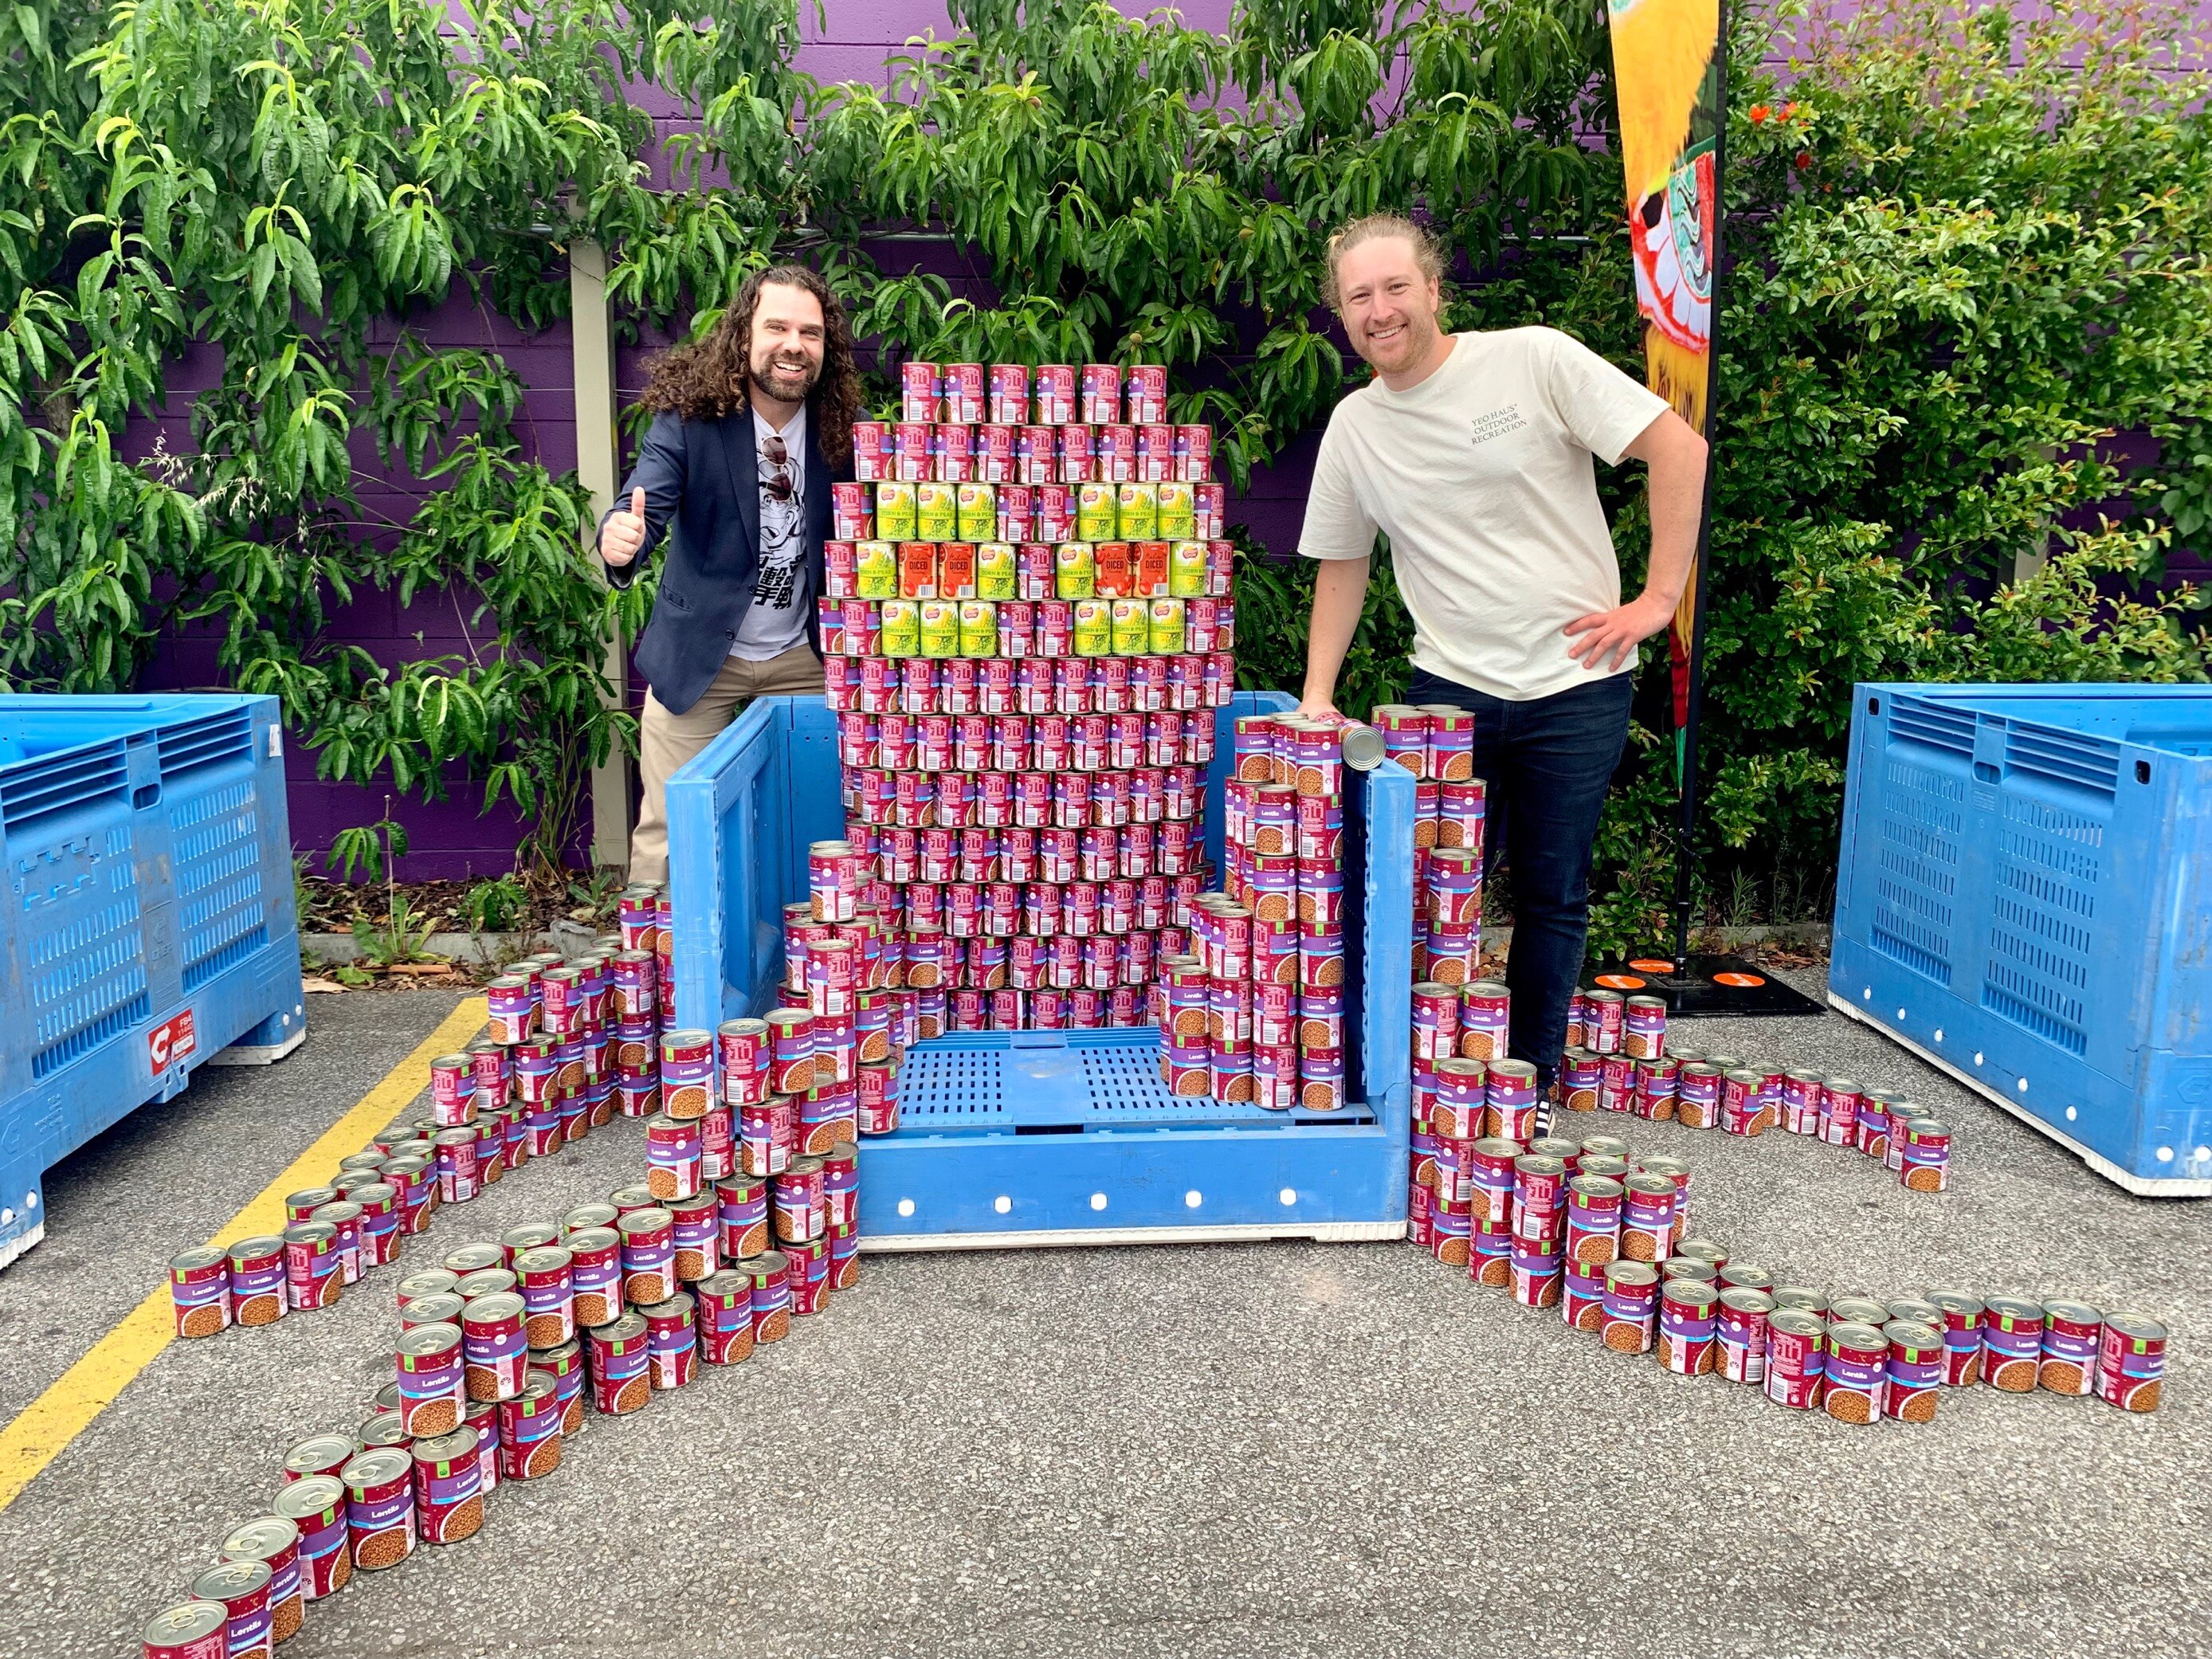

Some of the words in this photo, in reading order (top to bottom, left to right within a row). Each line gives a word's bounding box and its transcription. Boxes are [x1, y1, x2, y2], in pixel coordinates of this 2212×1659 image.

[1472, 415, 1489, 426] YEO
[1474, 412, 1520, 435] OUTDOOR
[1471, 419, 1528, 445] RECREATION
[909, 561, 928, 570] DICED
[950, 561, 968, 570] DICED
[1106, 560, 1124, 569] DICED
[1145, 560, 1163, 569] DICED
[1631, 1211, 1653, 1221] Lentils
[192, 1286, 215, 1296] Lentils
[1618, 1303, 1640, 1312] Lentils
[469, 1344, 489, 1353] Lentils
[2056, 1341, 2082, 1352] Lentils
[1841, 1369, 1867, 1379] Lentils
[422, 1376, 449, 1387] Lentils
[457, 1471, 478, 1489] Lentils
[371, 1504, 399, 1519] Lentils
[272, 1571, 296, 1590] Lentils
[231, 1620, 261, 1637] Lentils
